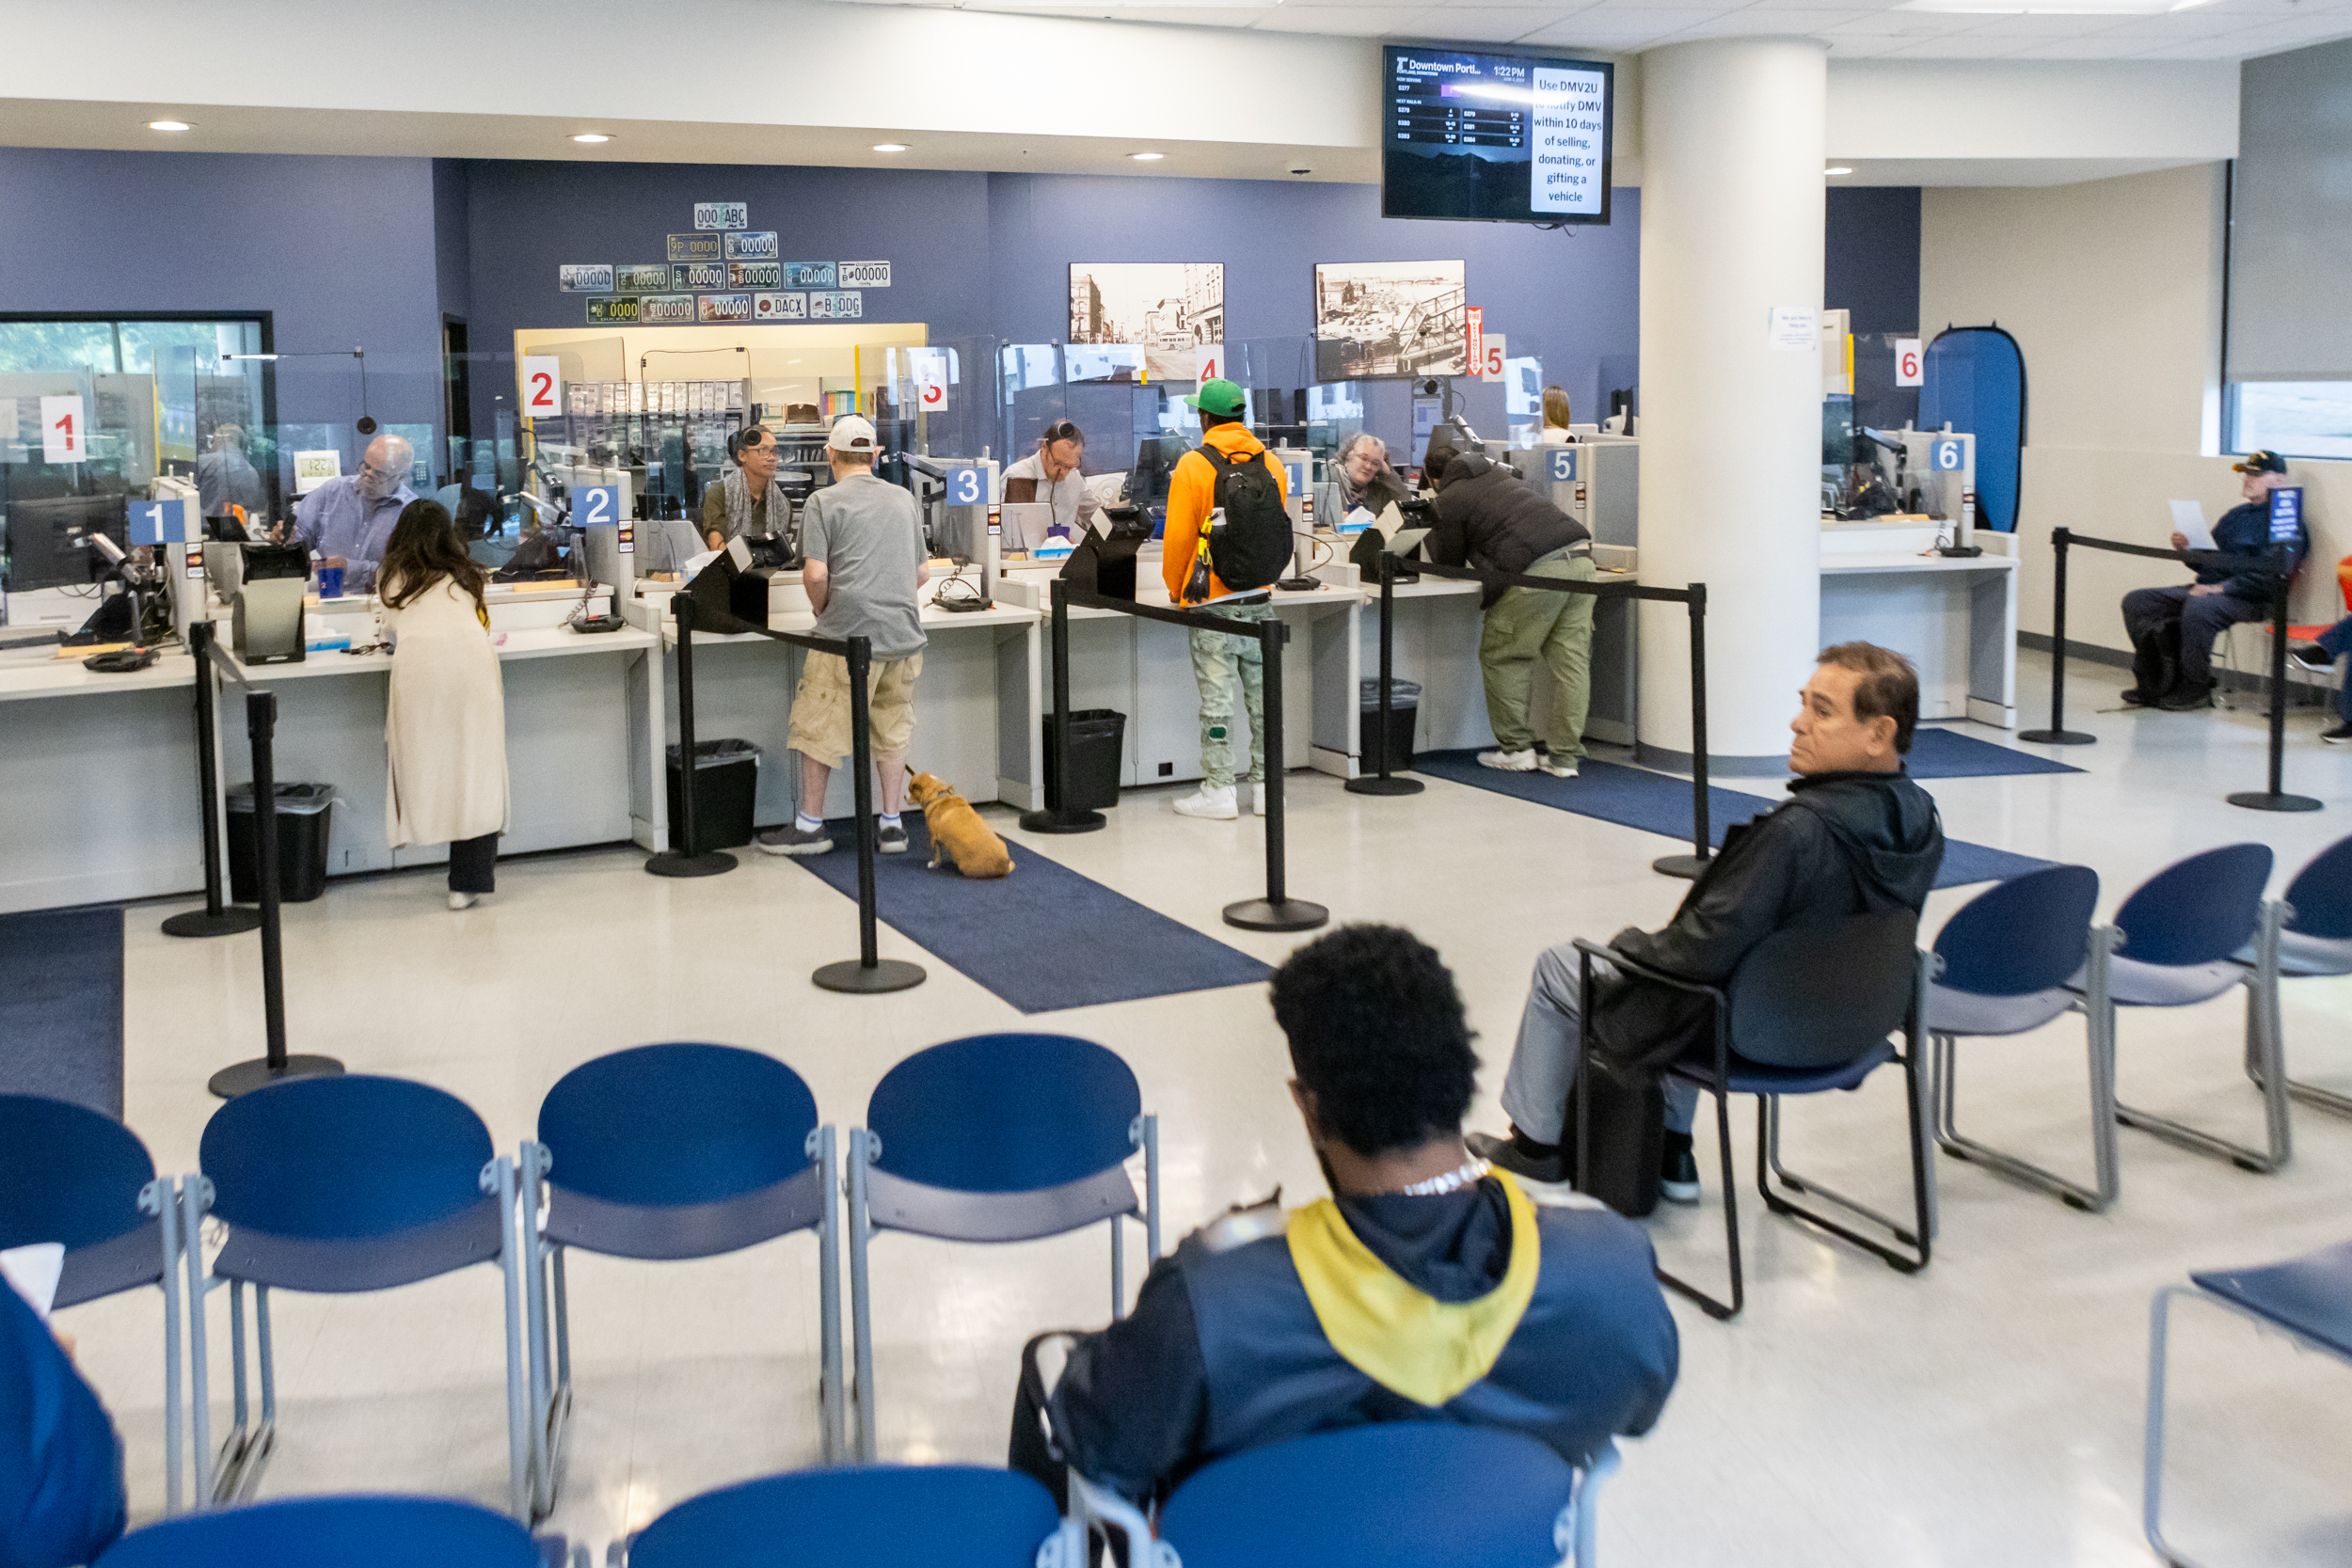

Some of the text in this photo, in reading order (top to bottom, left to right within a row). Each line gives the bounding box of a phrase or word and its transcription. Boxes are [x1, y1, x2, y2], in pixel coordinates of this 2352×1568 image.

[1409, 59, 1454, 73] Downtown
[1494, 66, 1524, 77] 1:22 PM
[1539, 80, 1597, 93] Use DMV2U
[1578, 102, 1601, 112] DMV
[1534, 117, 1601, 132] within 10 days
[1545, 135, 1590, 150] of selling,
[1538, 153, 1596, 167] donating, or
[1547, 173, 1579, 185] gifting
[1549, 191, 1582, 201] vehicle
[724, 209, 744, 223] ABC
[776, 299, 802, 312] DACX
[825, 298, 832, 311] B
[1487, 348, 1502, 374] 5
[1902, 352, 1917, 377] 6
[1201, 359, 1218, 382] 4
[532, 372, 553, 406] 2
[924, 372, 942, 404] 3
[56, 414, 73, 451] 1
[1939, 441, 1958, 469] 6
[1554, 451, 1571, 480] 5
[958, 470, 979, 502] 3
[586, 488, 610, 523] 2
[146, 504, 164, 542] 1
